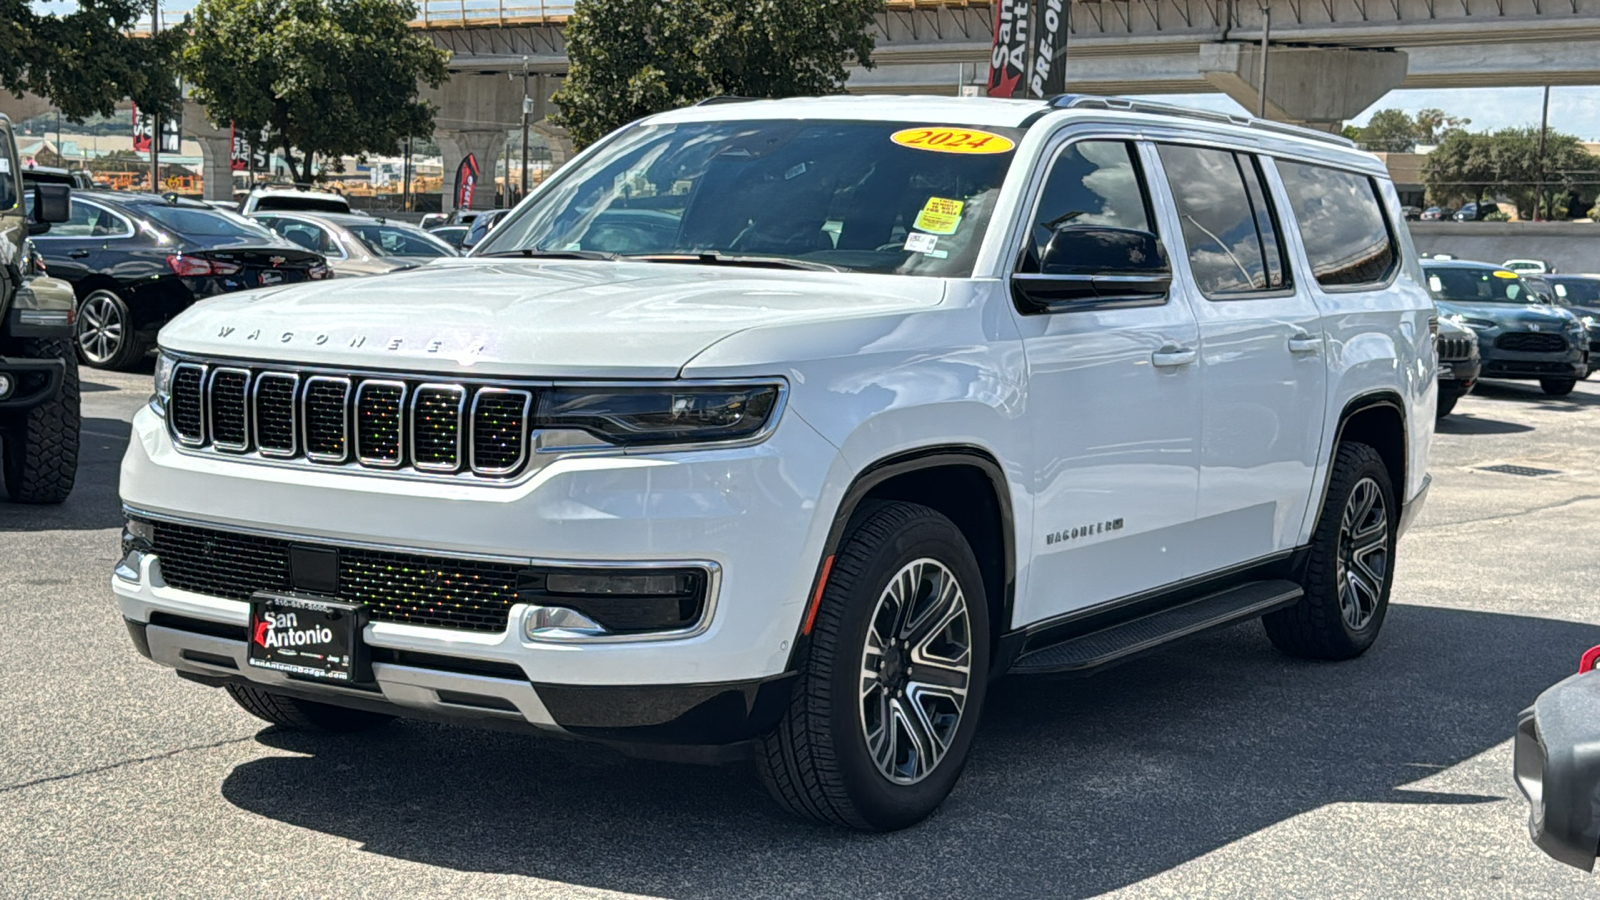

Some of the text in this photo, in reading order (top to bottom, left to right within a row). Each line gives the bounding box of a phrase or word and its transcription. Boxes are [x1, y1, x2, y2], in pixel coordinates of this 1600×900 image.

[992, 0, 1013, 69] San
[905, 131, 995, 149] 2024
[218, 326, 484, 354] WAGONEER
[1046, 521, 1112, 545] WAGONEER
[264, 611, 298, 629] San
[265, 624, 333, 648] Antonio
